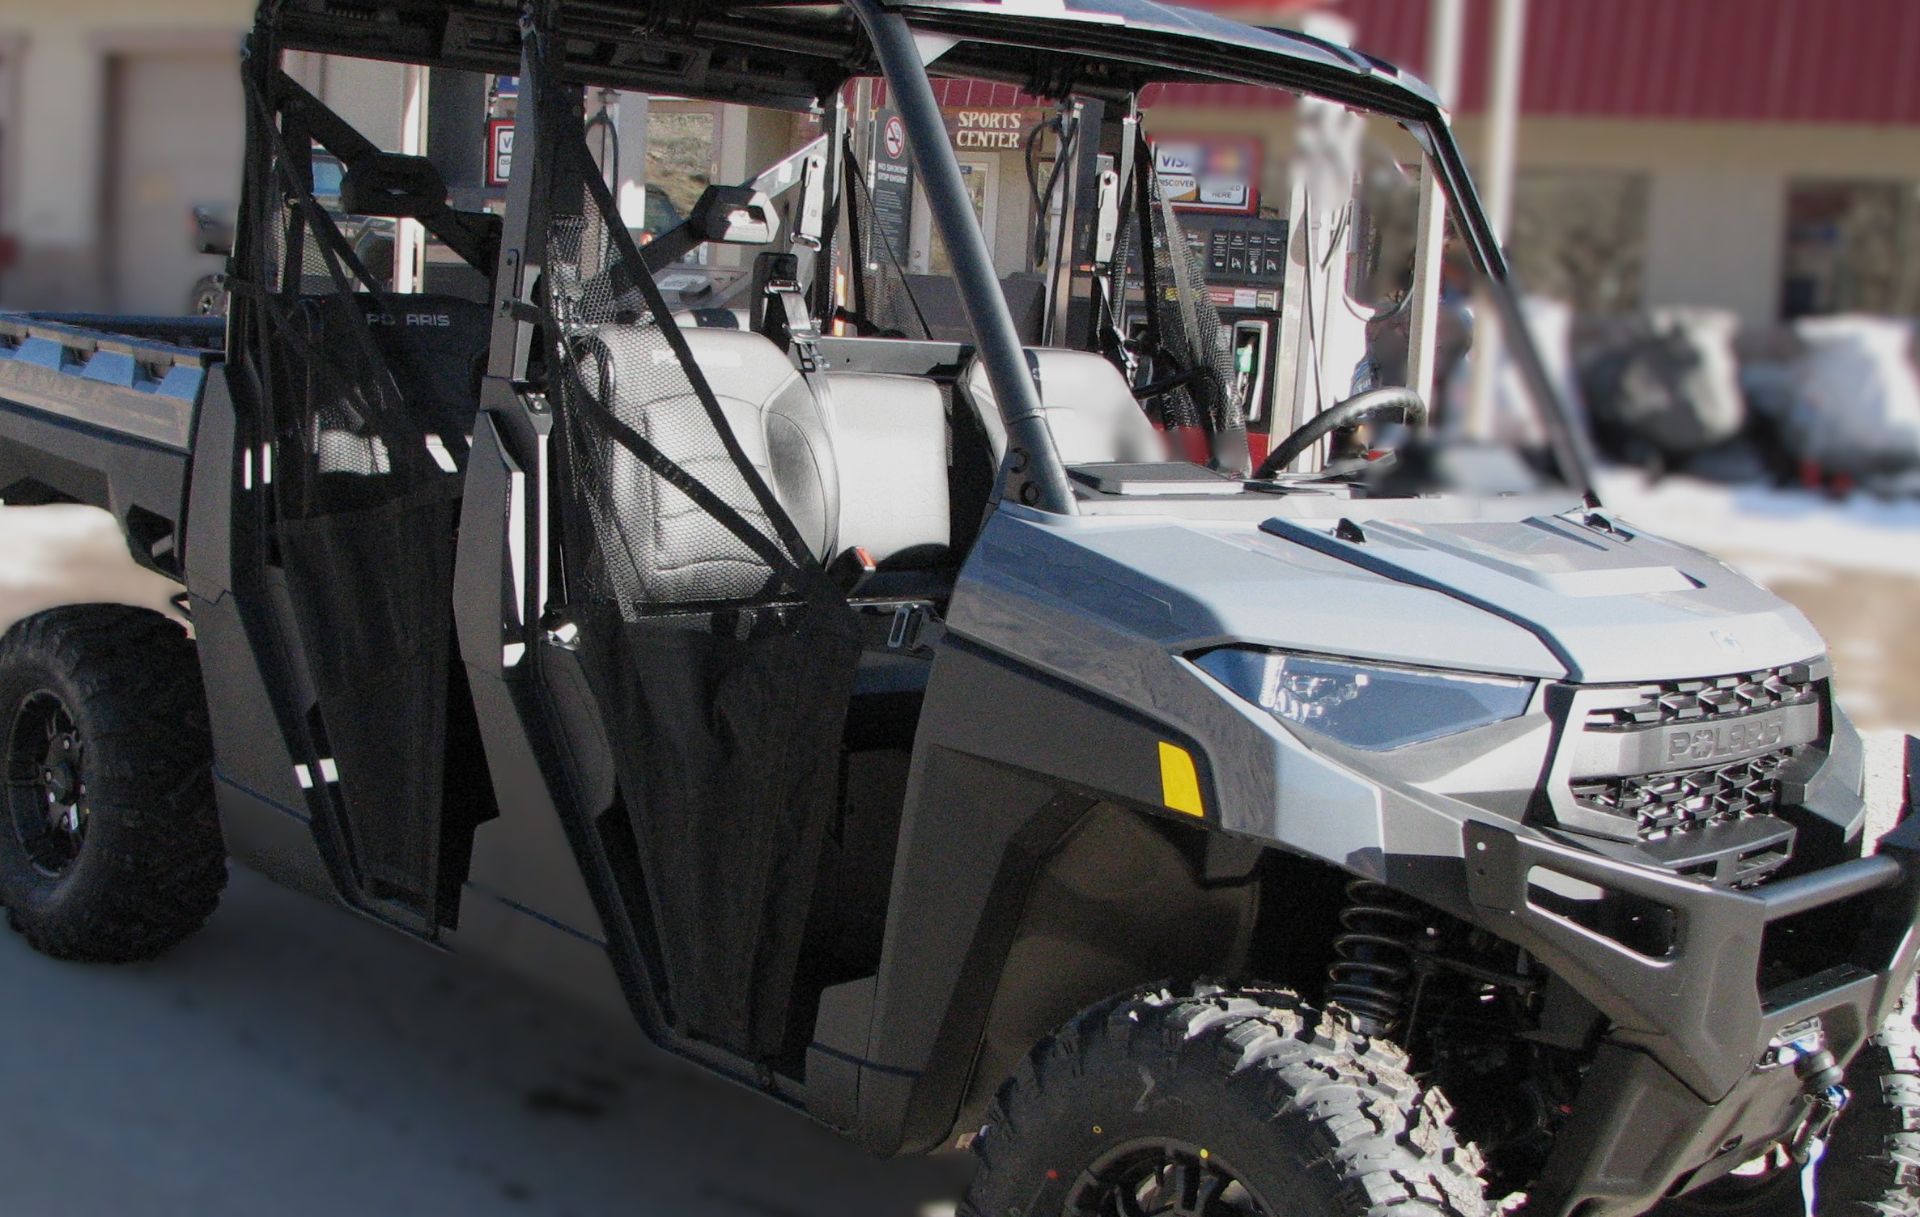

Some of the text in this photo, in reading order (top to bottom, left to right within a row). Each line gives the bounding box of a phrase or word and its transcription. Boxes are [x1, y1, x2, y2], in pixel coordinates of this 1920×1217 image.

[958, 111, 1021, 129] SPORTS
[956, 130, 1020, 149] CENTER
[1161, 154, 1189, 169] VIS
[367, 313, 450, 326] POARIS
[1667, 716, 1785, 765] POLARIS
